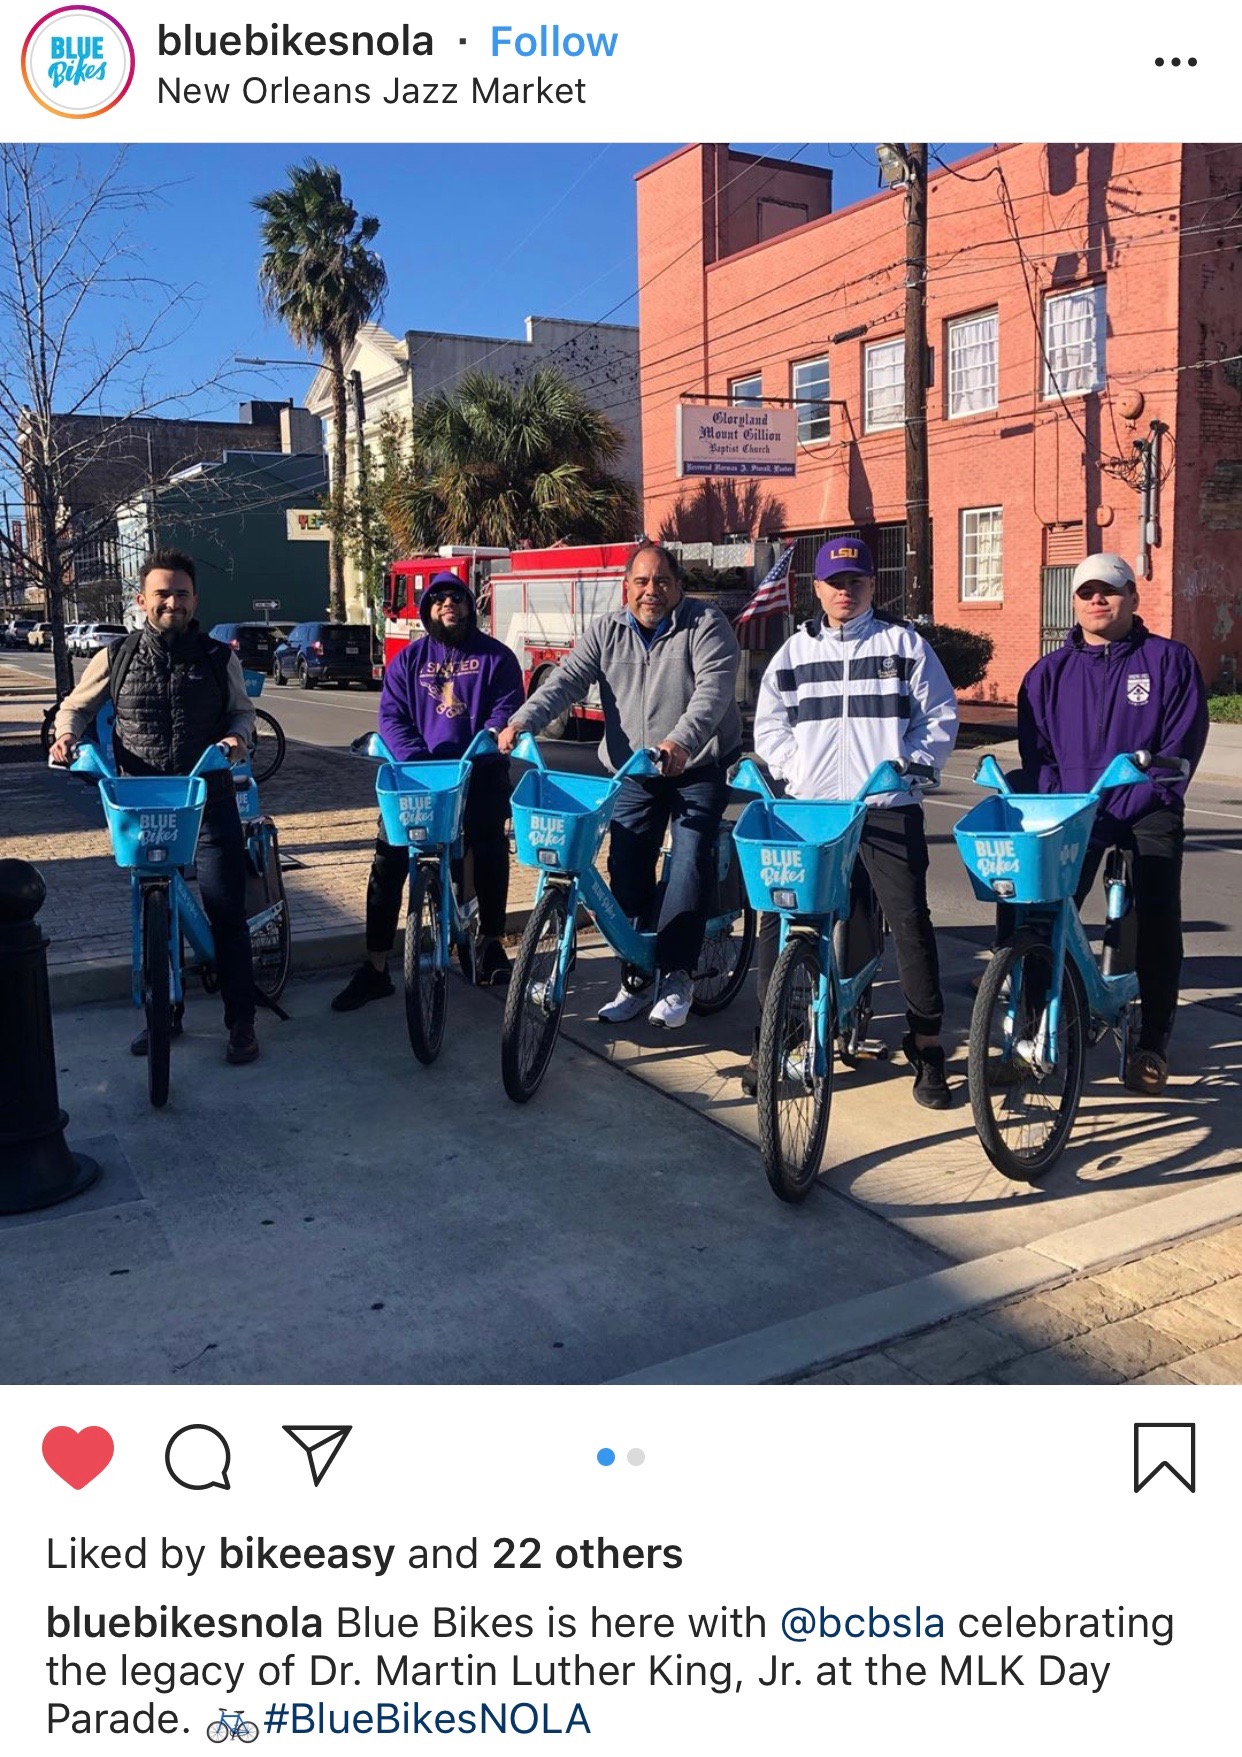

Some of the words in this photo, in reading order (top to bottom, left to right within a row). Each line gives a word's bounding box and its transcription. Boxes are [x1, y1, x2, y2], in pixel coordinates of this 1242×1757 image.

[712, 411, 768, 428] Gloryland
[699, 426, 738, 440] Mount
[743, 428, 781, 441] Gillion
[709, 443, 739, 455] Baptist
[742, 444, 771, 454] Church
[830, 547, 859, 560] LSU
[427, 658, 480, 674] SED
[236, 793, 248, 805] UE
[399, 796, 432, 811] BLUE
[140, 814, 177, 829] BLUE
[399, 808, 435, 827] Bikes
[530, 815, 565, 833] BLUE
[137, 827, 179, 847] Bikes
[528, 829, 567, 848] Bikes
[761, 848, 803, 867] BLUE
[974, 840, 1016, 858] BLUE
[760, 864, 806, 887] Bikes
[976, 856, 1020, 878] Bikes
